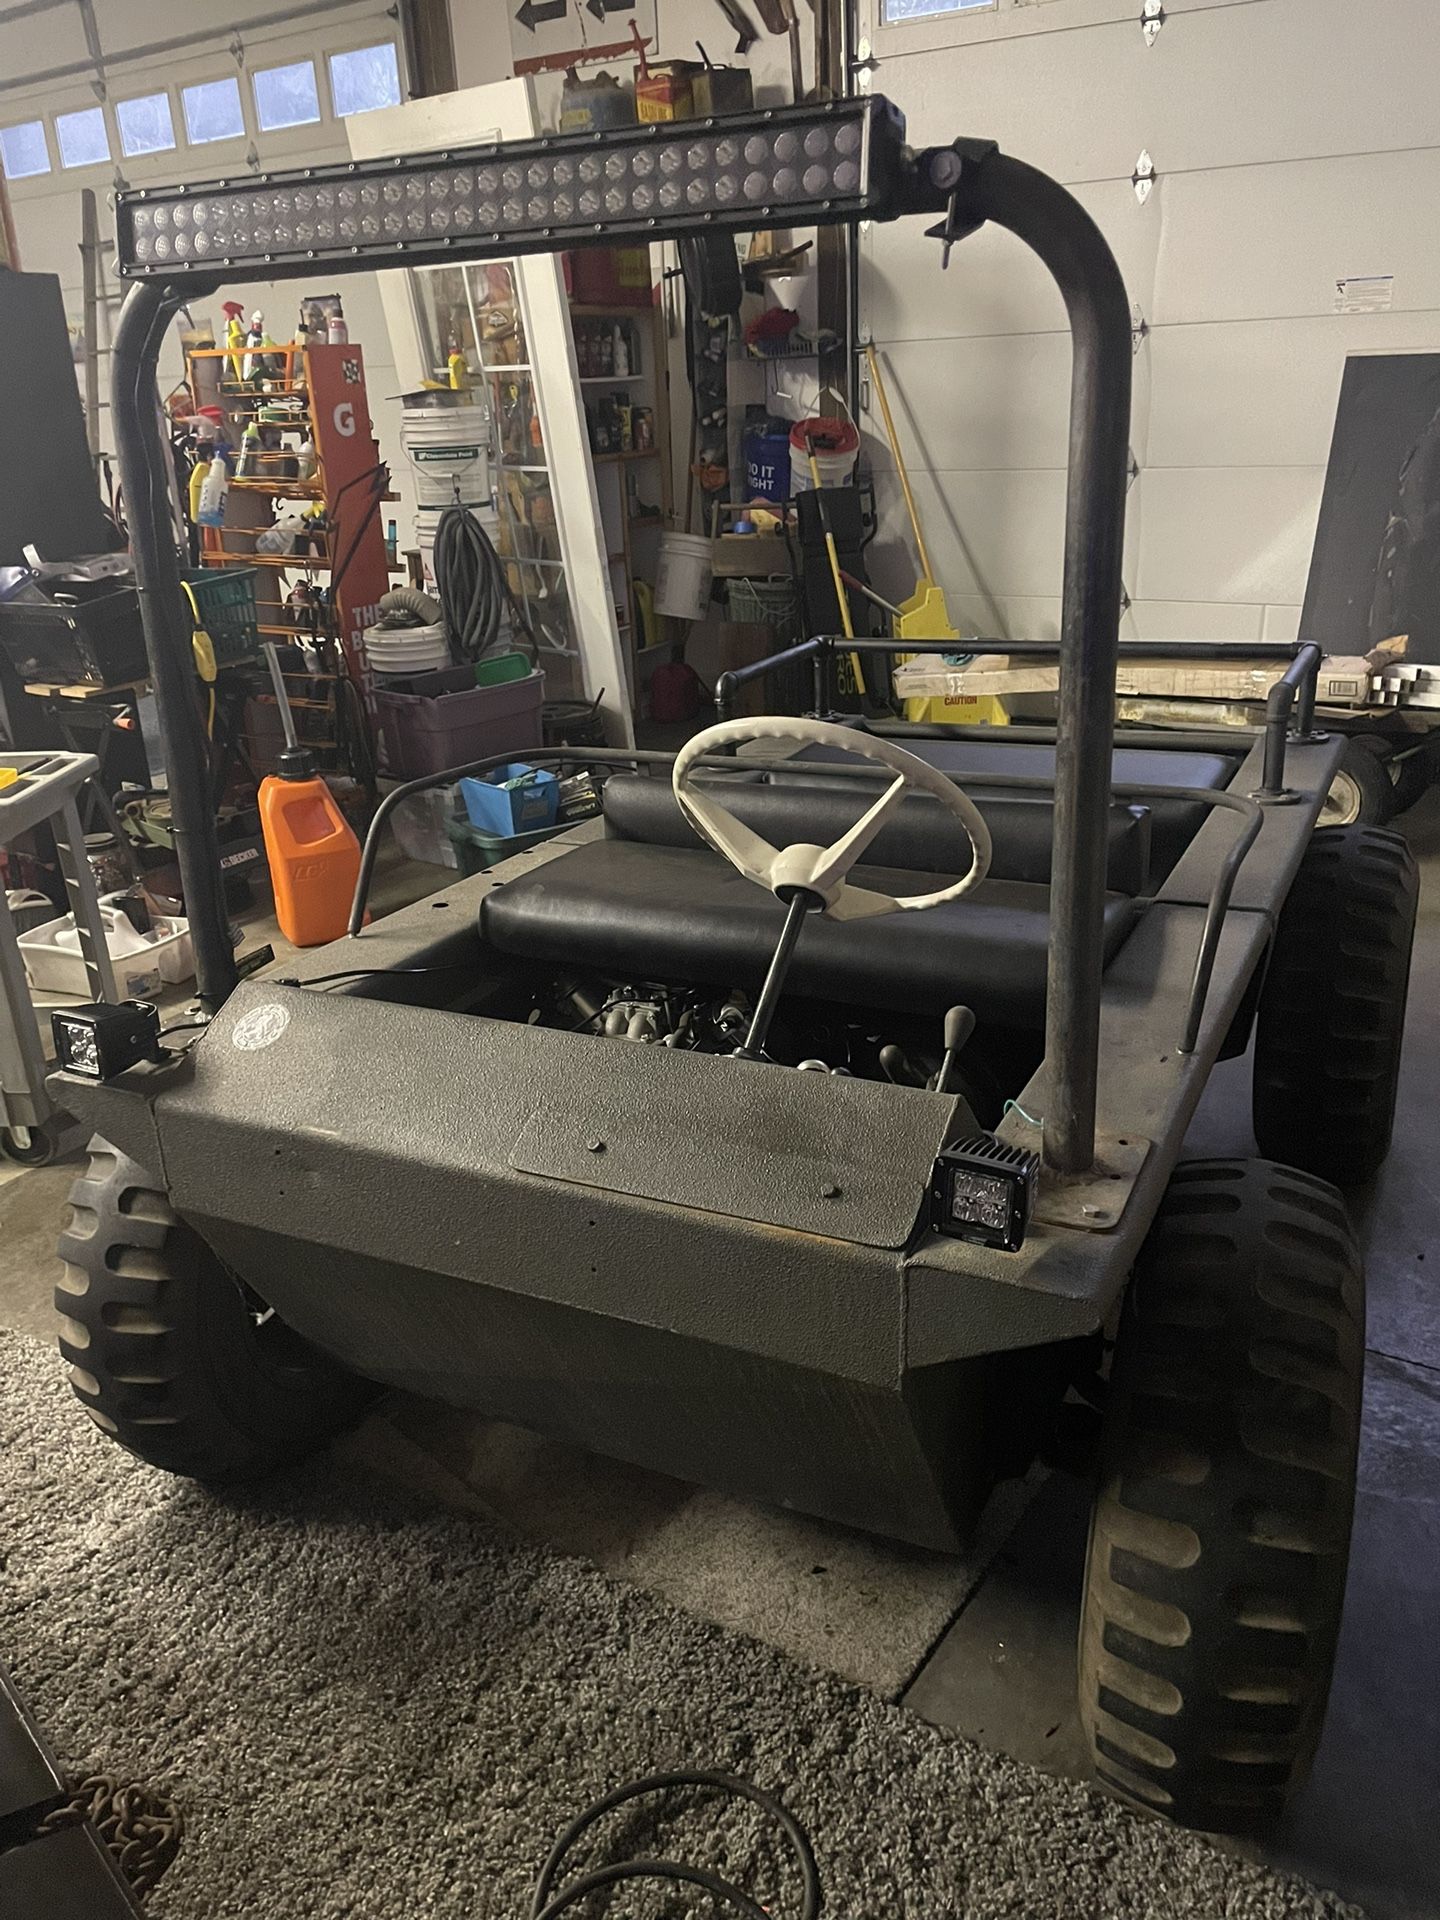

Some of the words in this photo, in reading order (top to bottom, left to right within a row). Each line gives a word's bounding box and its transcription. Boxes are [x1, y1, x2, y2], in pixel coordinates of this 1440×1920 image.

[333, 402, 356, 437] G
[761, 465, 775, 478] IT
[352, 603, 383, 628] THE
[944, 695, 977, 706] CAUTION
